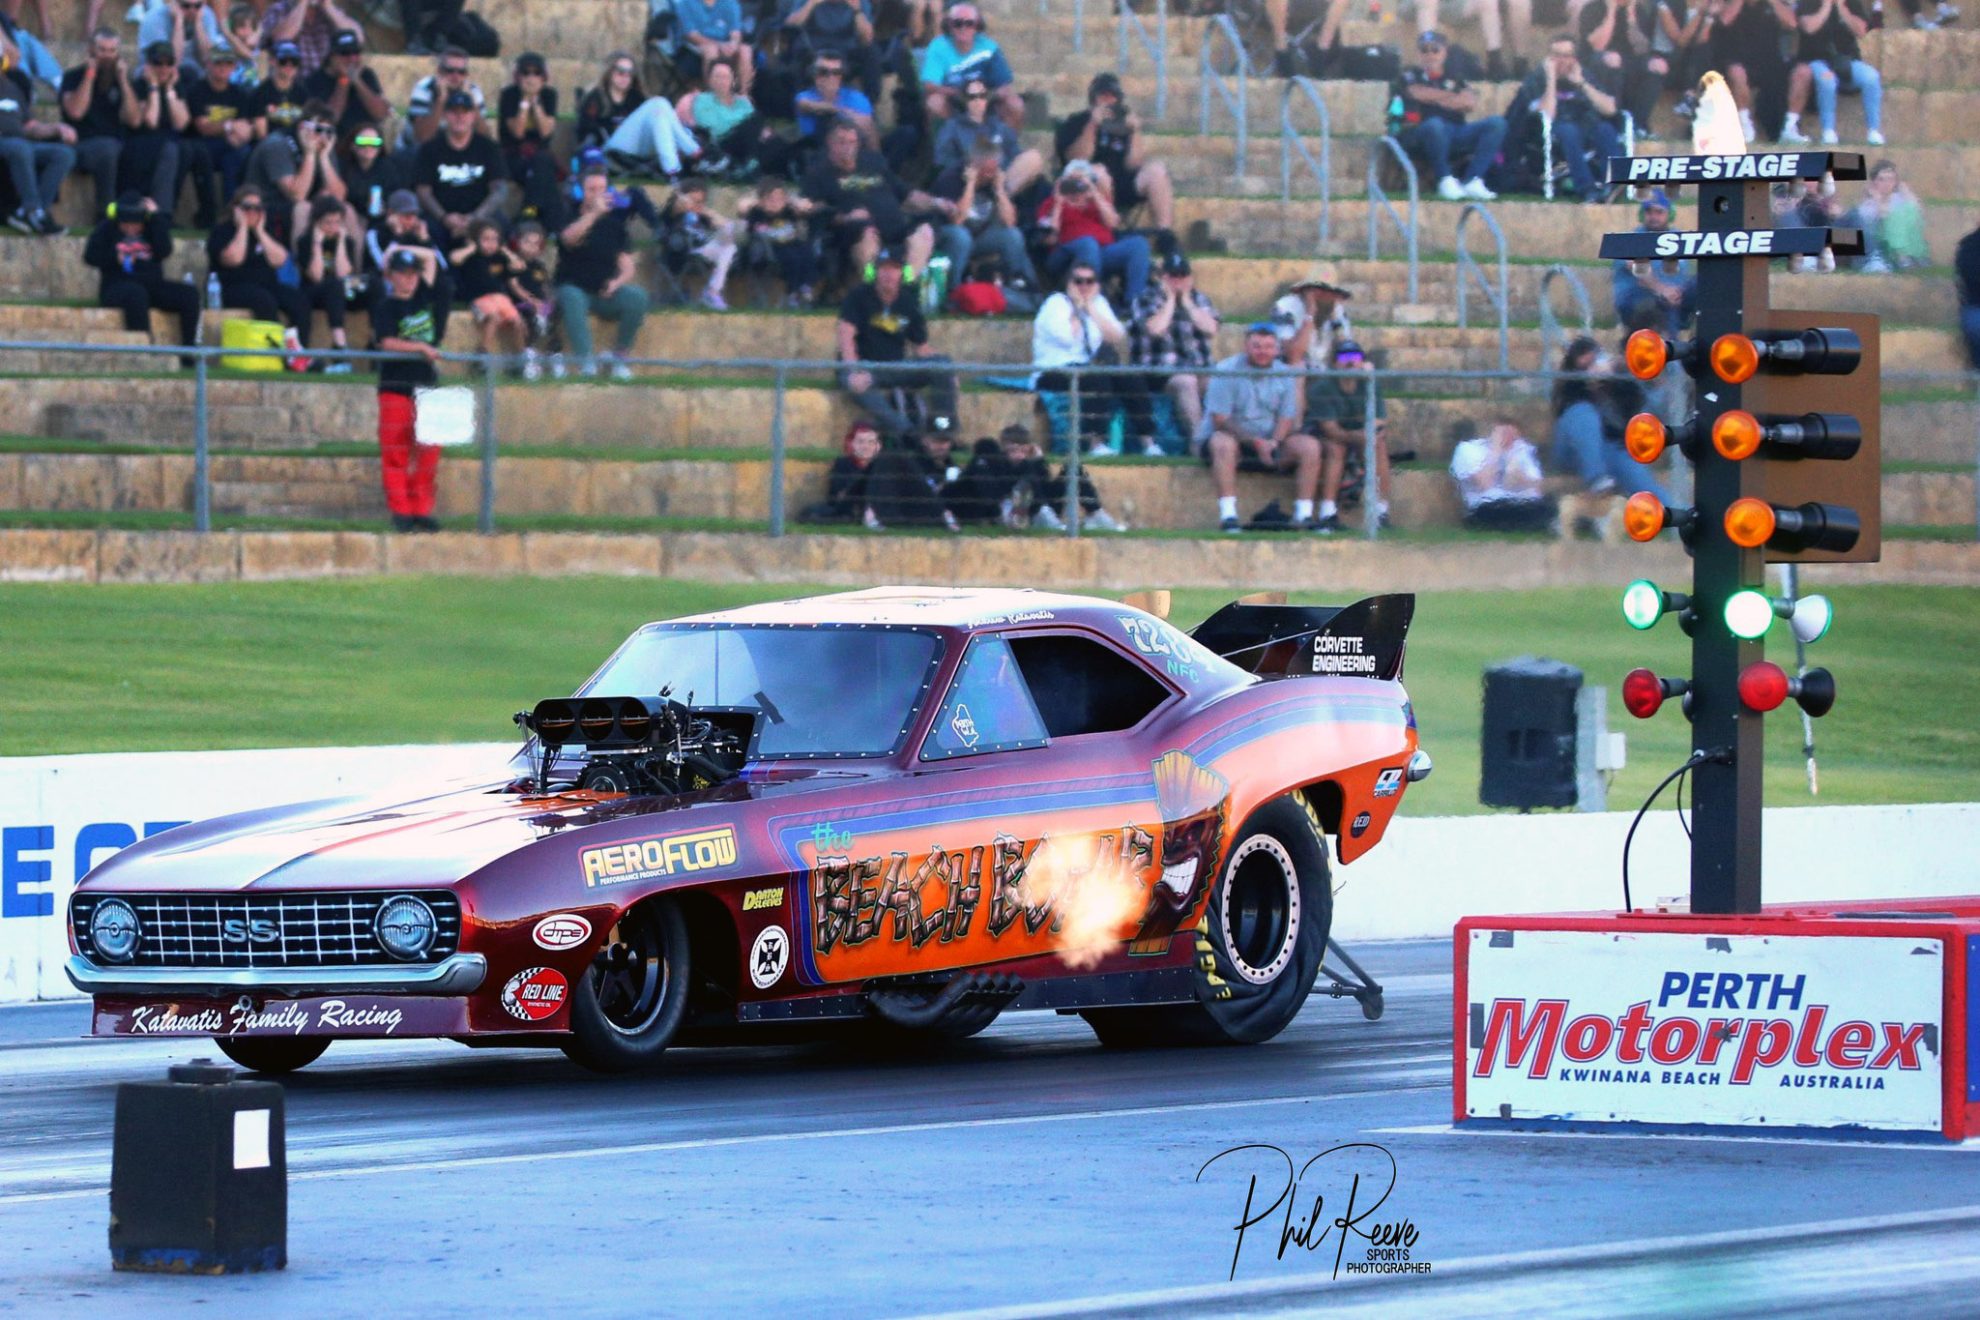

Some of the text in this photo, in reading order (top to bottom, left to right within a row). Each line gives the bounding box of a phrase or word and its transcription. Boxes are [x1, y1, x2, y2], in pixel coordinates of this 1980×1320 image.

[1629, 154, 1799, 180] PRE-STAGE
[1655, 231, 1774, 255] STAGE
[1314, 636, 1363, 653] CORVETTE
[1167, 659, 1200, 683] NFC
[1312, 655, 1376, 672] ENGINEERING
[811, 822, 855, 851] the
[583, 829, 737, 888] AEROFLOW
[600, 869, 667, 885] PERFORMANCE PRODUCTS
[814, 846, 984, 955] BEACH
[223, 918, 280, 943] SS
[521, 984, 564, 1001] RED LINE
[1658, 971, 1806, 1011] PERTH
[130, 1000, 403, 1035] Katavatis Family Racing
[1473, 998, 1927, 1085] Motorplex
[1560, 1068, 1885, 1090] KWINANA BEACH AUSTRALIA
